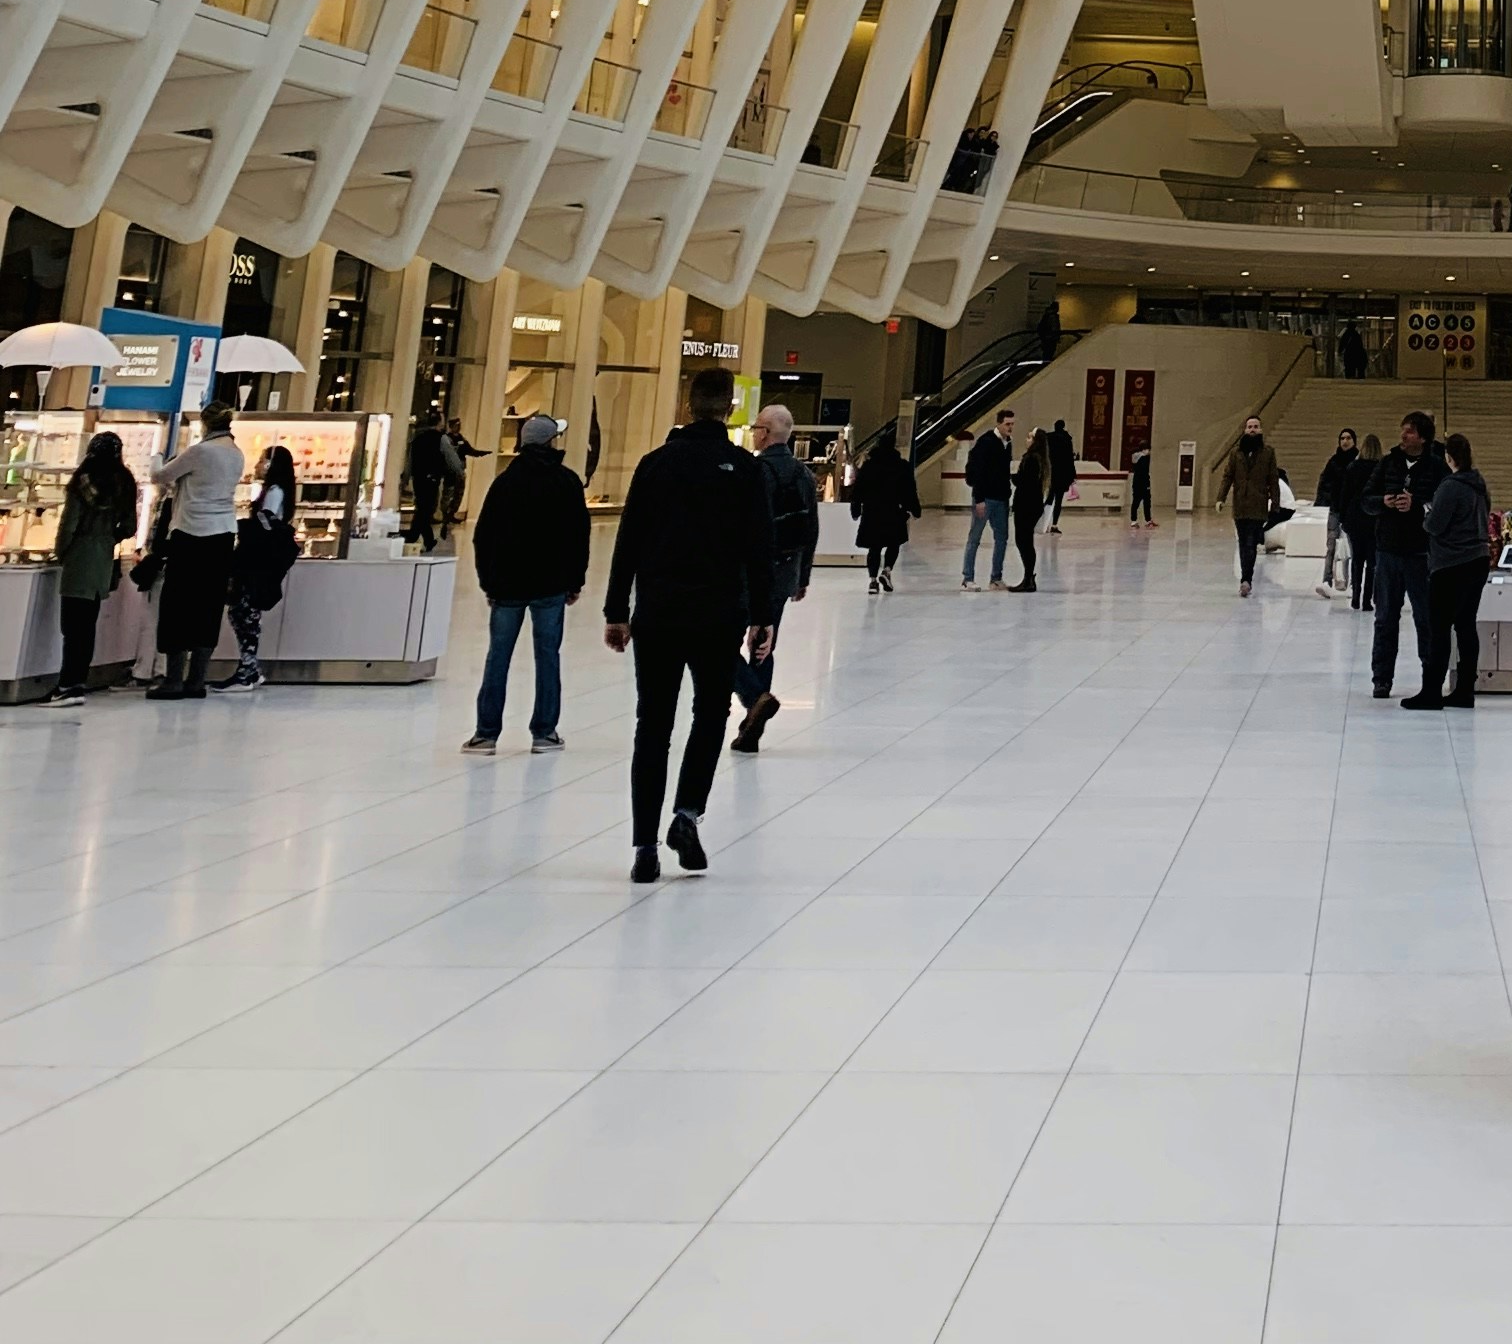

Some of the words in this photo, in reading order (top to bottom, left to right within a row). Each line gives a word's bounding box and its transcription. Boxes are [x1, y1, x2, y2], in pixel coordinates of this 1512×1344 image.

[229, 254, 256, 277] OSS
[123, 346, 159, 355] HANAMI
[682, 341, 705, 357] ENUS
[713, 343, 739, 359] FLEUR
[116, 366, 158, 377] JEWELRY
